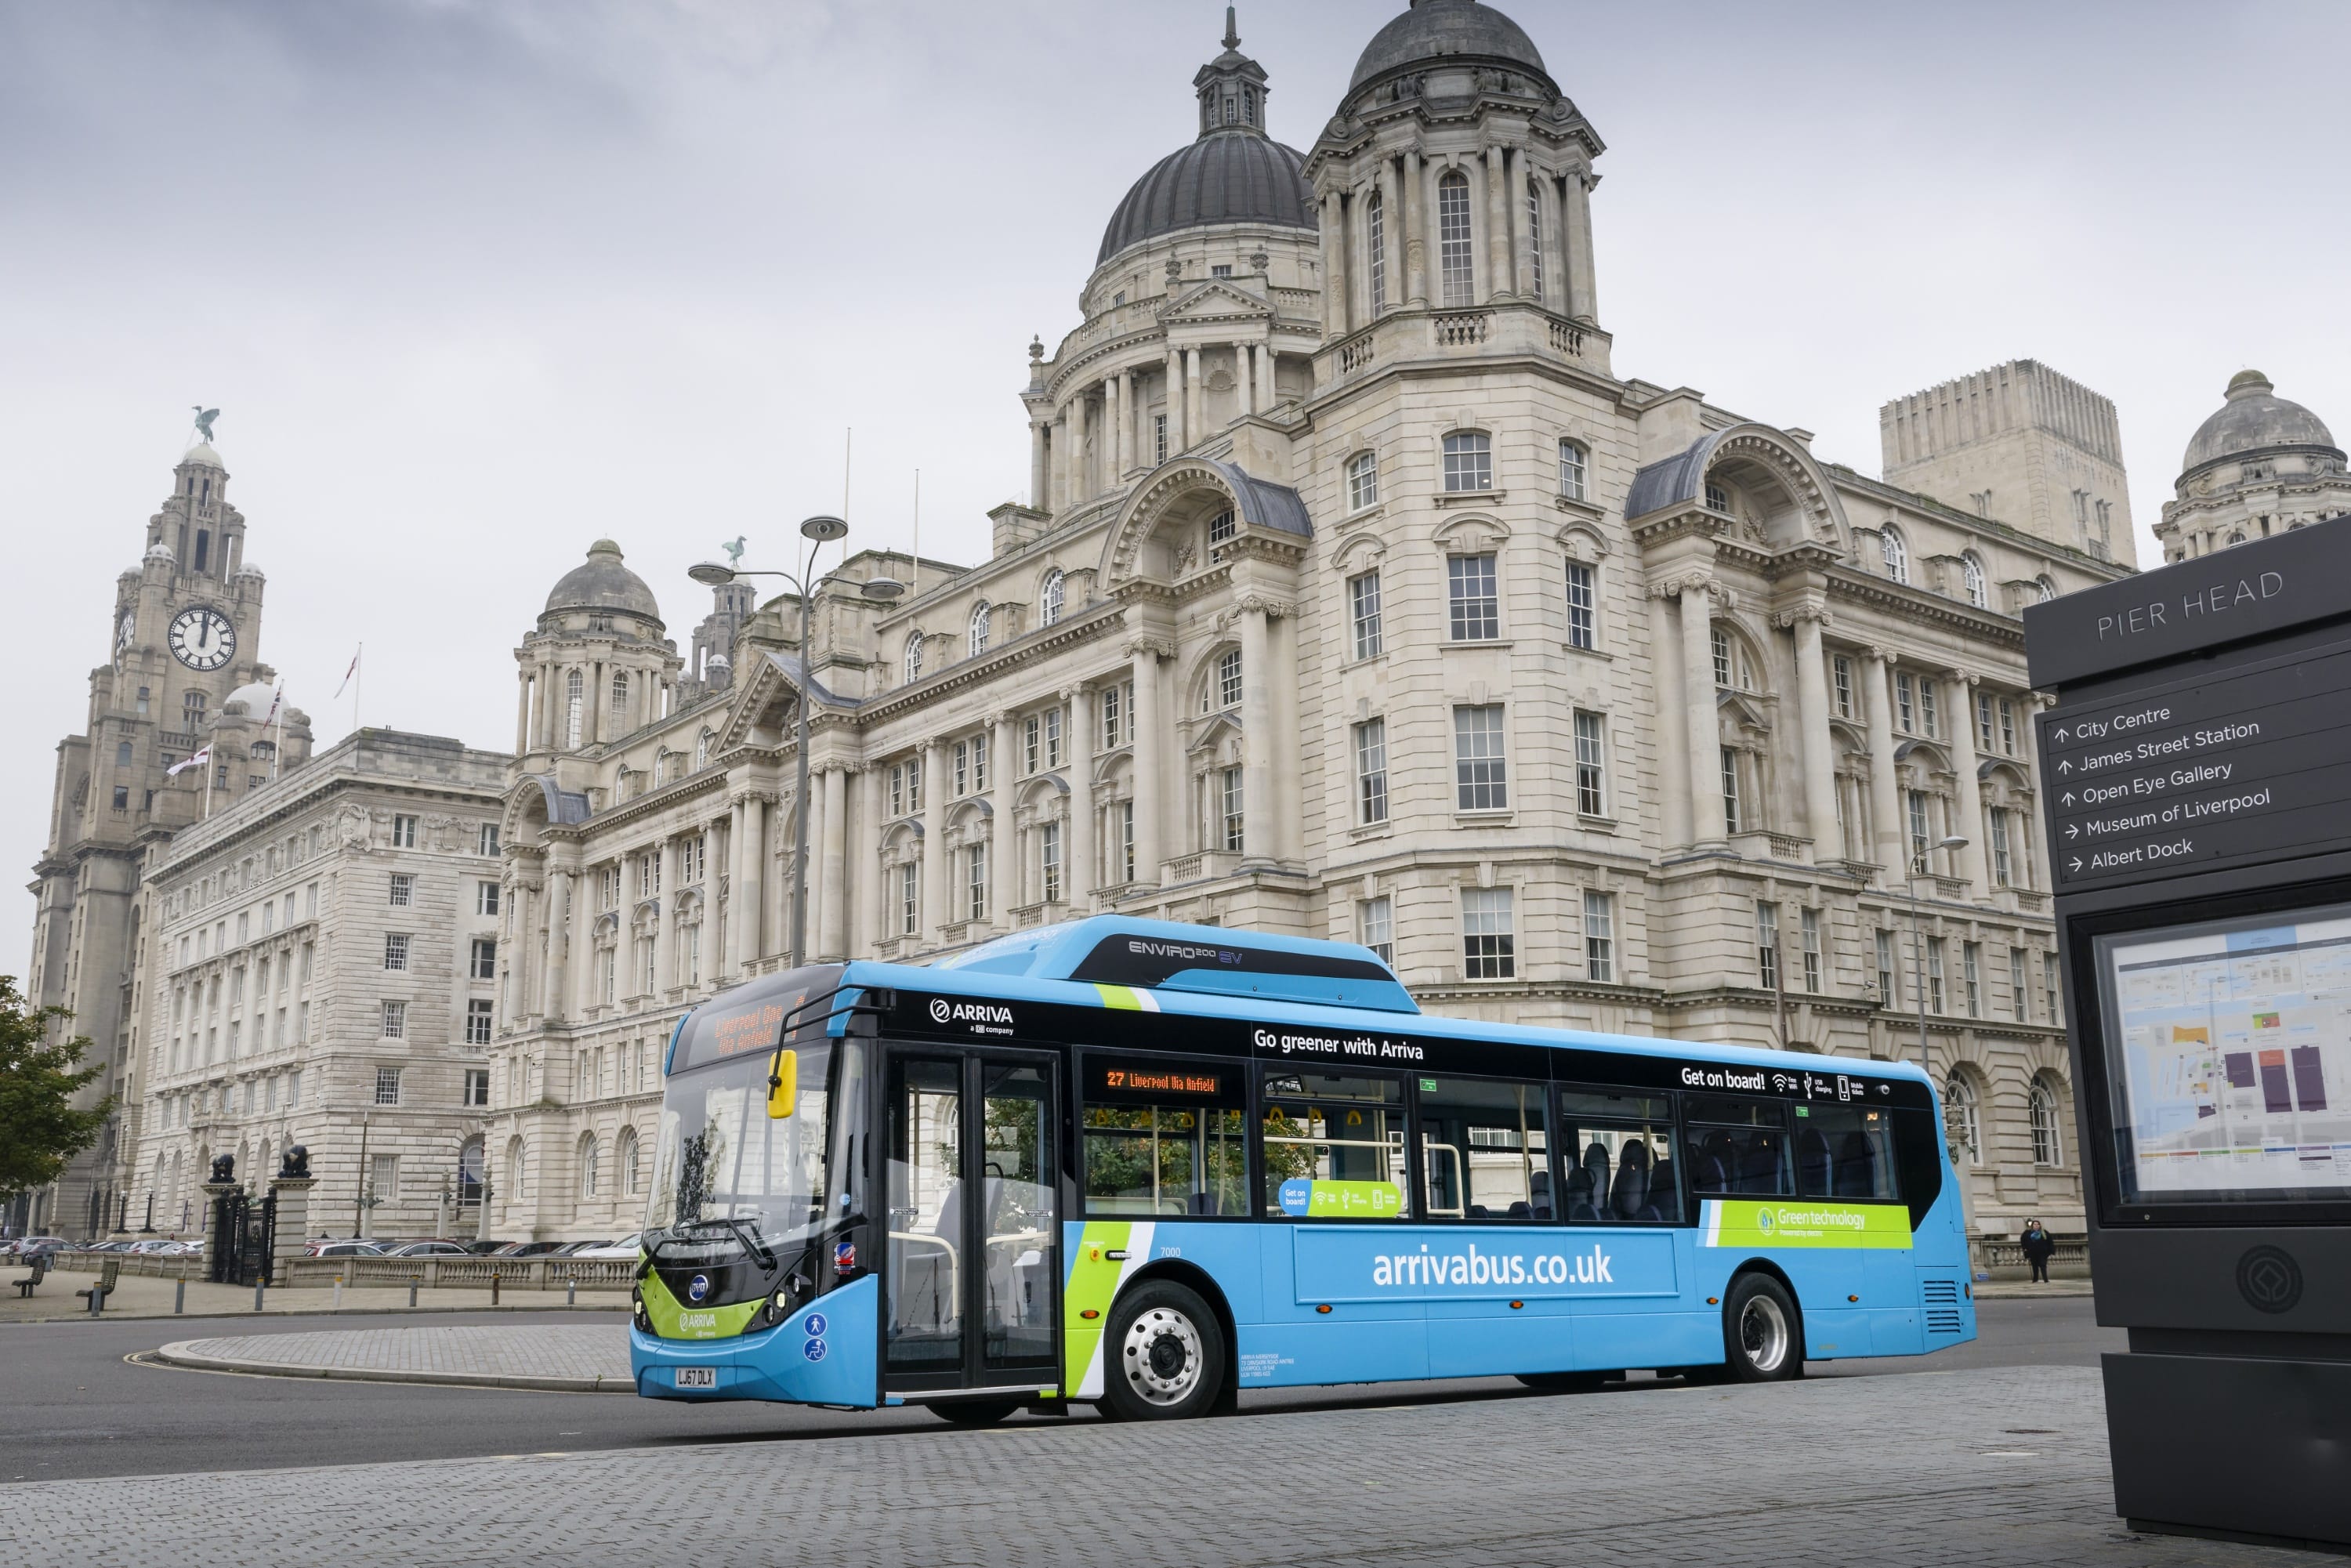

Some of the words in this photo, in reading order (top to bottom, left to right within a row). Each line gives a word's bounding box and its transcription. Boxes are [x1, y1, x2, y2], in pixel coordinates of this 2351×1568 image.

[2097, 602, 2166, 641] PIER
[2183, 571, 2283, 619] HEAD
[2076, 722, 2108, 738] City
[2113, 708, 2170, 730] Centre
[2080, 749, 2132, 771] James
[2137, 735, 2190, 759] Street
[2194, 722, 2260, 746] Station
[2083, 784, 2128, 803] Open
[2133, 777, 2165, 795] Eye
[2171, 763, 2233, 786] Gallery
[2087, 812, 2157, 836] Museum
[2161, 804, 2180, 822] of
[2184, 788, 2270, 818] Liverpool
[2091, 847, 2143, 870] Albert
[2147, 838, 2193, 860] Dock
[1219, 951, 1243, 965] EV
[763, 1004, 783, 1025] One
[952, 1004, 1014, 1023] ARRIVA
[986, 1027, 1014, 1036] company
[1254, 1029, 1277, 1048] Go
[1281, 1034, 1339, 1053] greener
[1343, 1037, 1377, 1056] with
[1381, 1040, 1424, 1060] Arriva
[1107, 1071, 1125, 1086] 27
[1130, 1073, 1168, 1089] Liverpool
[1186, 1077, 1215, 1092] Anfield
[1682, 1067, 1704, 1086] Get
[1707, 1073, 1723, 1088] on
[1726, 1070, 1766, 1090] board!
[1778, 1208, 1809, 1225] Green
[1810, 1209, 1866, 1229] technology
[1161, 1248, 1181, 1257] 7000
[1373, 1244, 1614, 1286] arrivabus.co.uk
[688, 1313, 715, 1327] ARRIVA
[678, 1370, 697, 1385] LJ67
[697, 1369, 712, 1385] DLX
